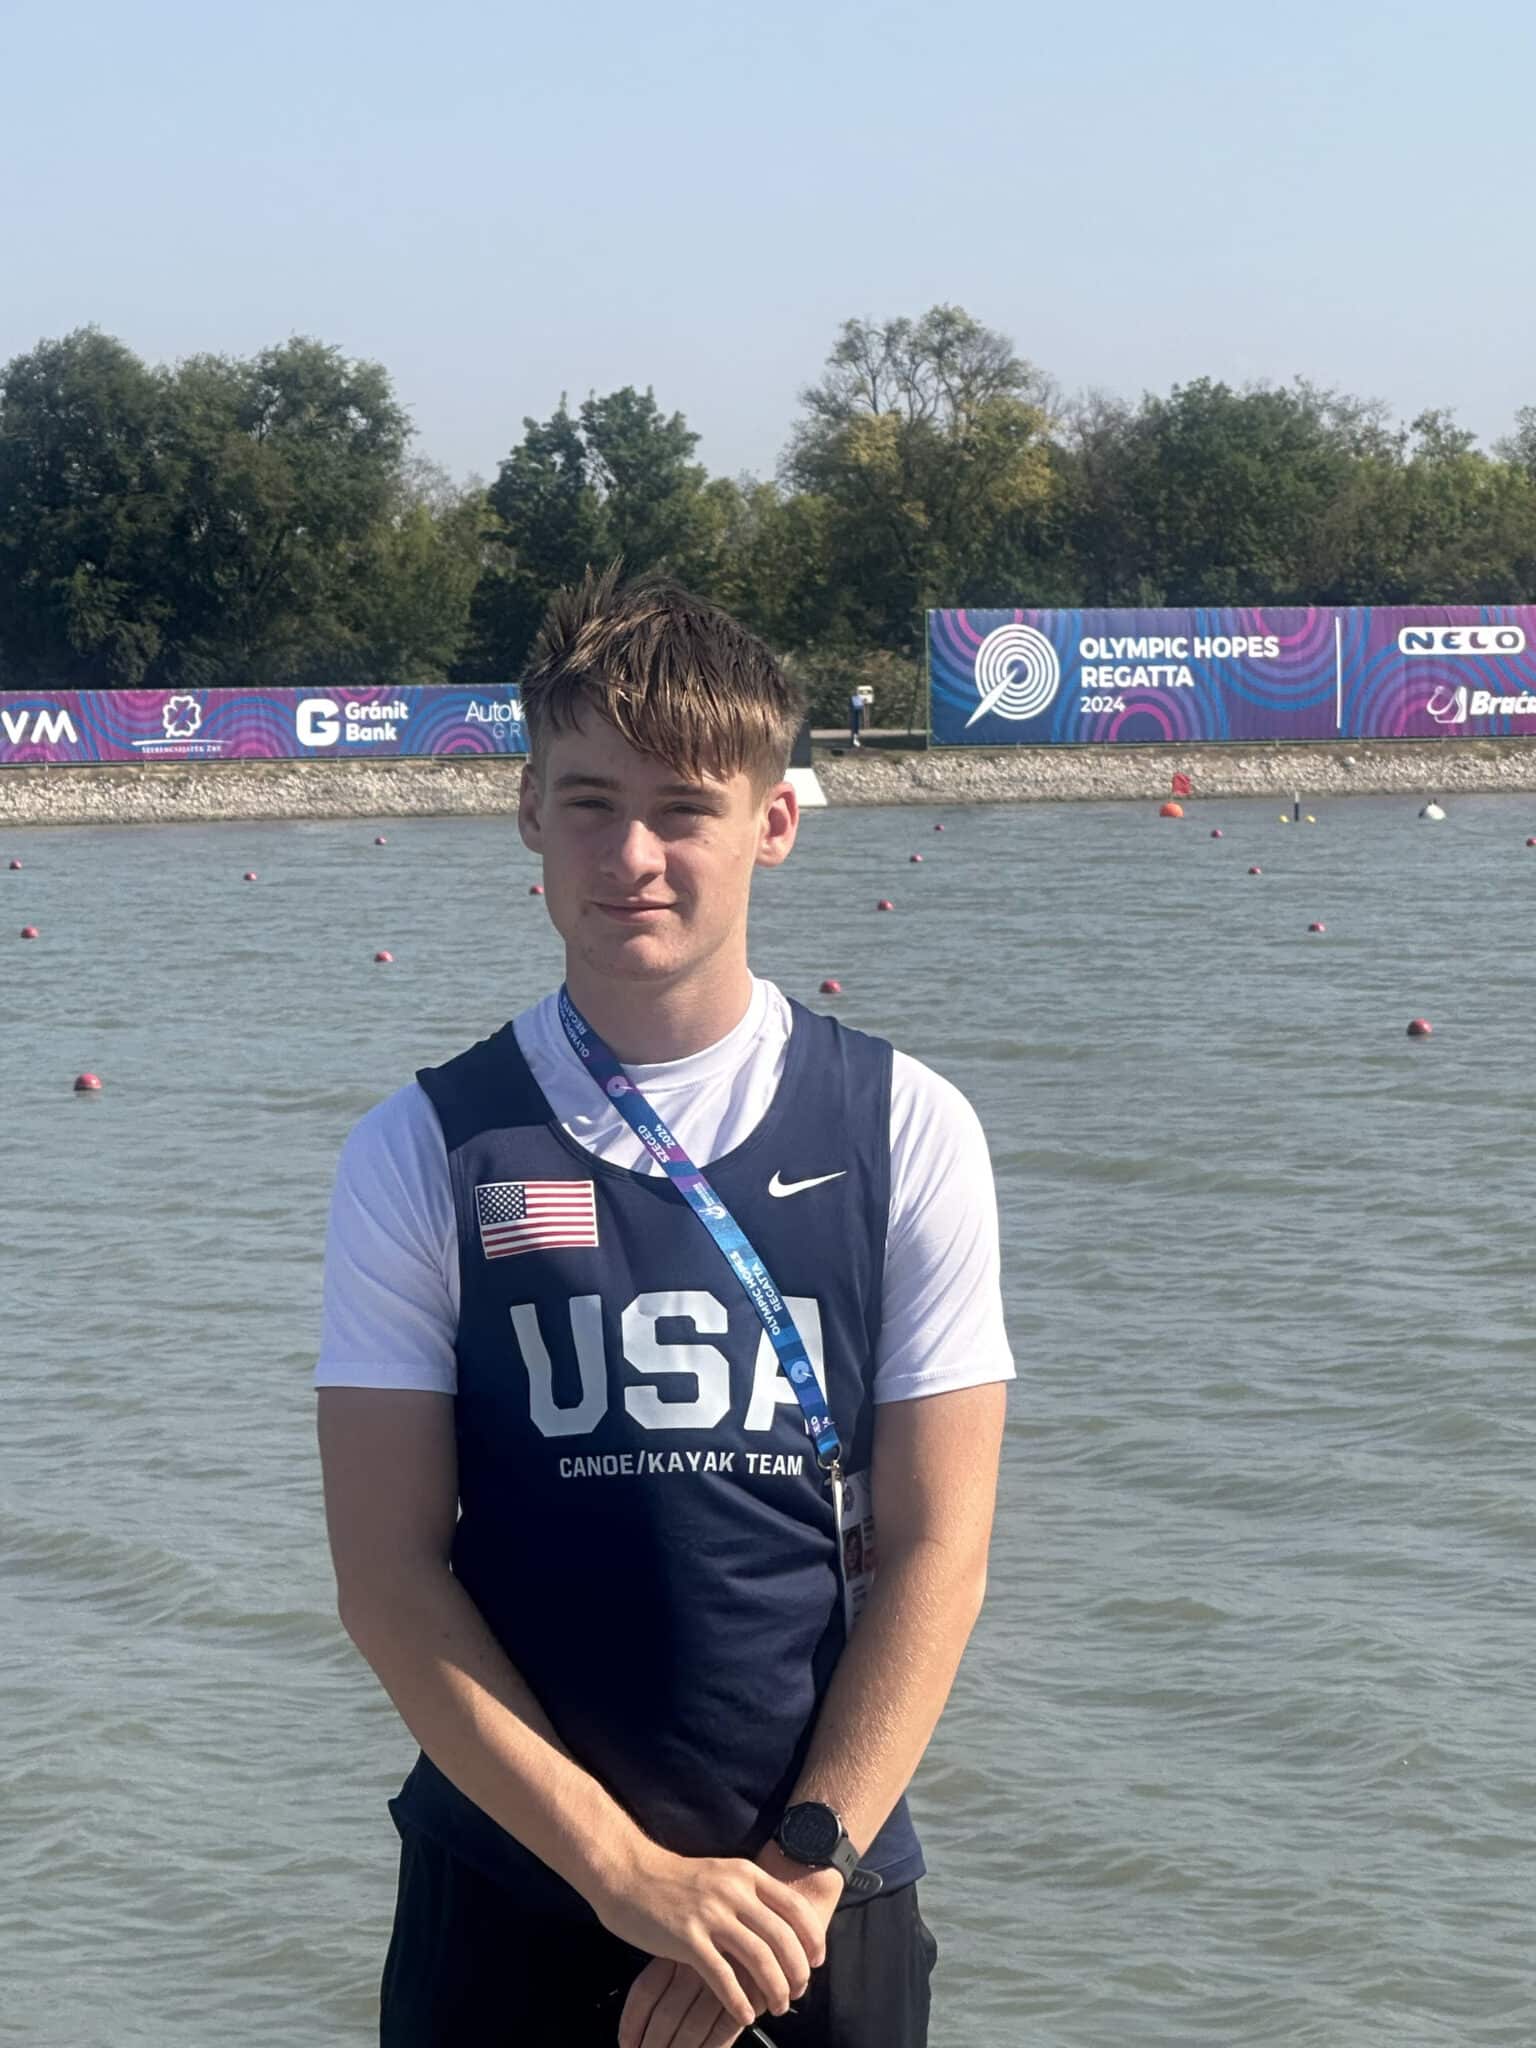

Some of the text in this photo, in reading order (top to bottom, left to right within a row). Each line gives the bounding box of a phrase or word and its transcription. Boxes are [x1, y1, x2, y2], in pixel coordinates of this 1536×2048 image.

[1080, 636, 1280, 660] OLYMPIC HOPES
[1405, 631, 1520, 650] NELO
[1081, 665, 1195, 688] REGATTA
[345, 701, 409, 721] Gránit
[1080, 695, 1126, 713] 2024
[345, 723, 398, 741] Bank
[637, 1124, 671, 1164] SZEGED
[654, 1123, 677, 1149] 2024
[750, 1262, 783, 1313] REGATTA
[751, 1290, 782, 1337] OLYMPIC
[510, 1290, 829, 1437] USA
[560, 1451, 804, 1478] CANOE/KAYAK TEAM
